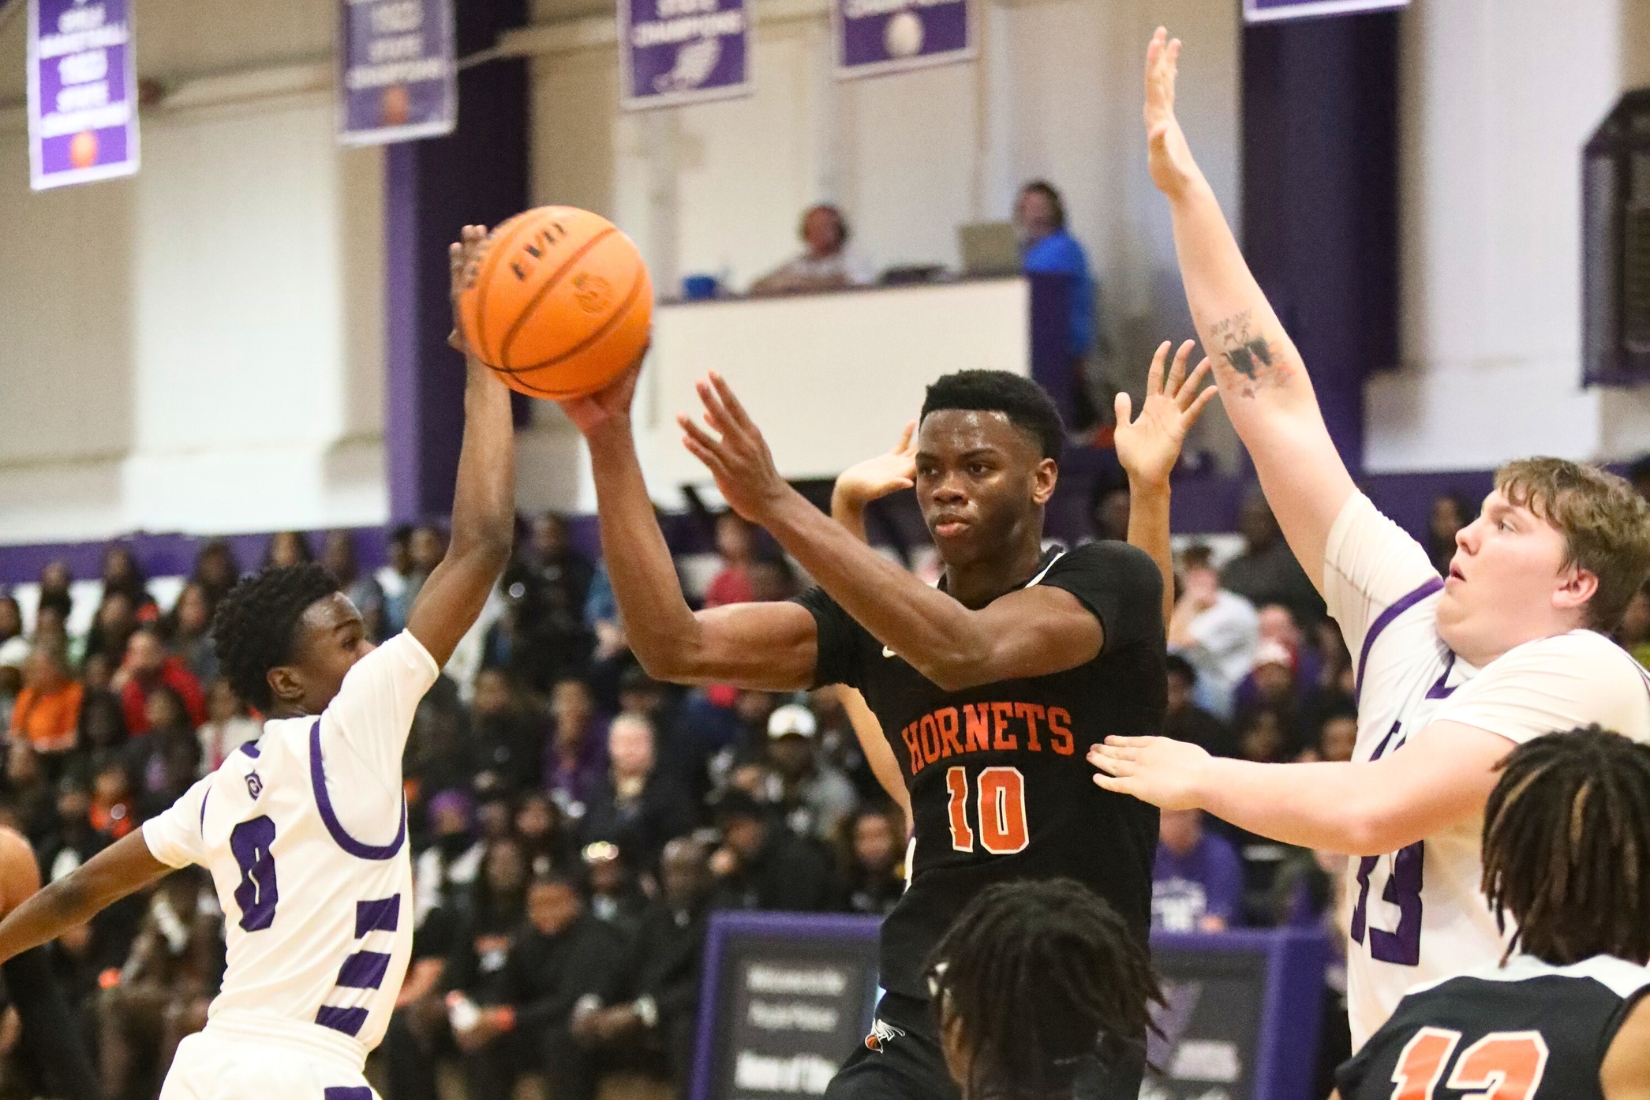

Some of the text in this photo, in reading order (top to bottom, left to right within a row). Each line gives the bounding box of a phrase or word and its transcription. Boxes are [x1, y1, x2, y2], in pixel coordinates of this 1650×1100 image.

[901, 701, 1075, 775] HORNETS
[946, 766, 1029, 854] 10
[229, 814, 279, 933] 0
